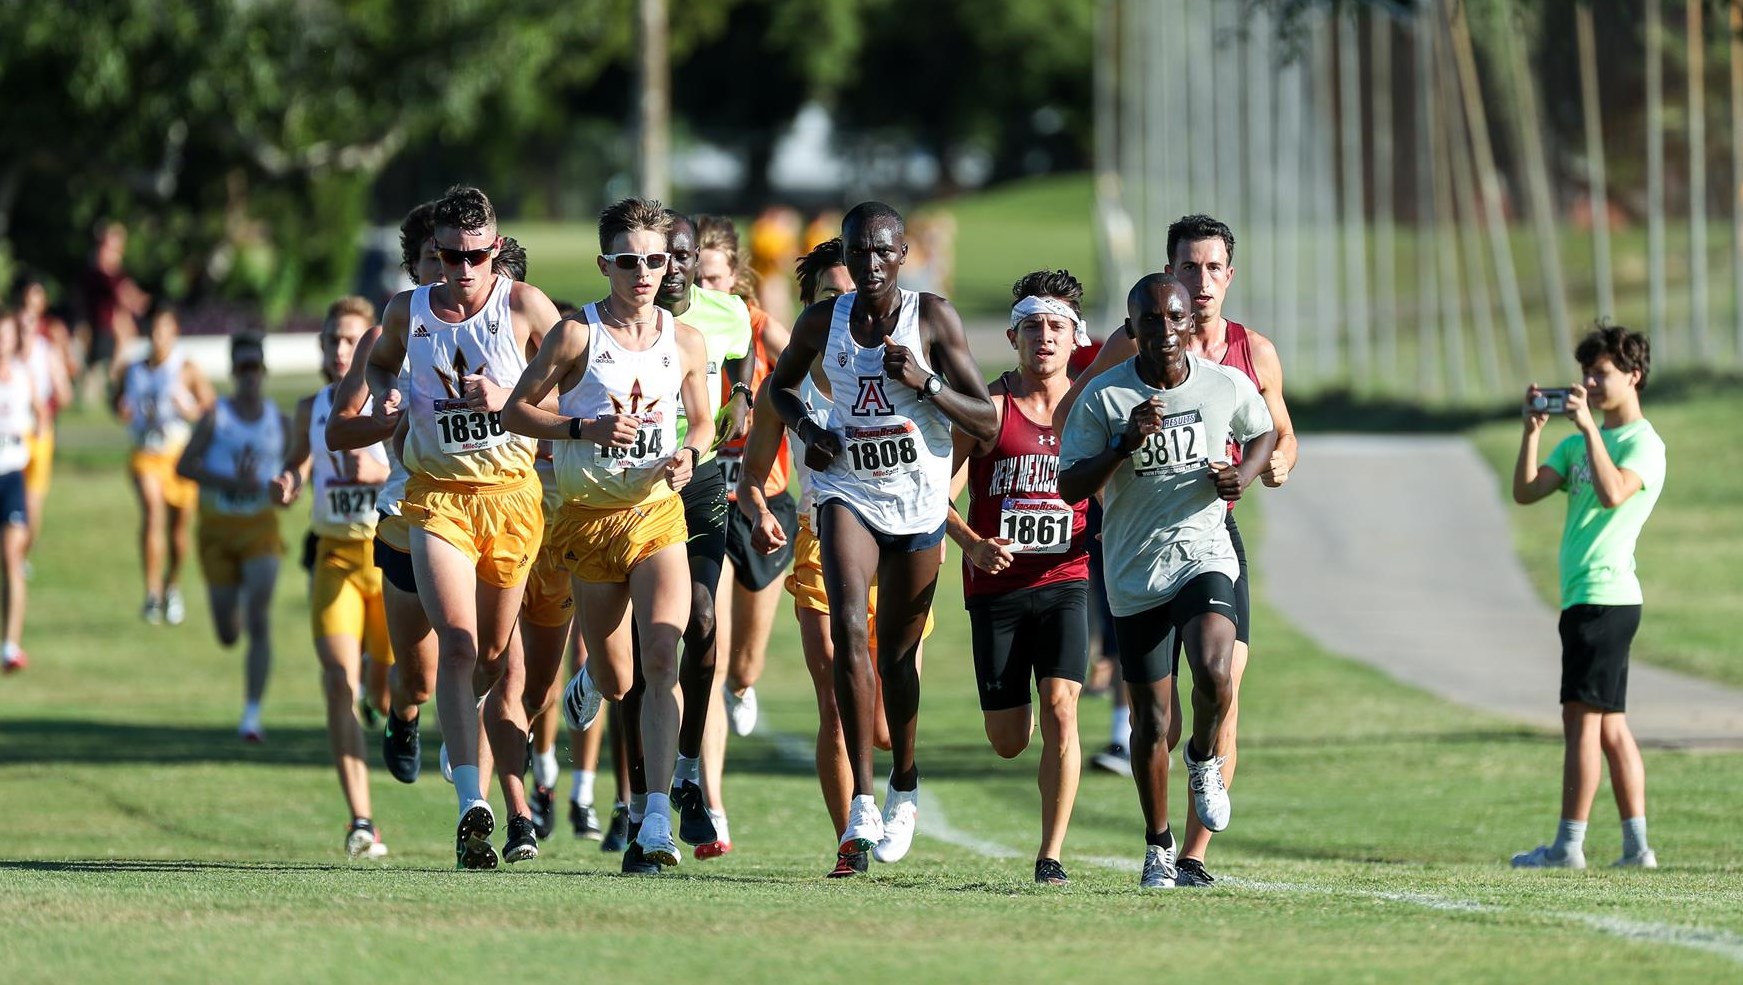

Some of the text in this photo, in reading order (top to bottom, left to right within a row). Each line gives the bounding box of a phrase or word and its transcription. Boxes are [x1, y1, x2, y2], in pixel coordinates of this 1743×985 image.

[852, 375, 896, 416] A
[438, 411, 506, 443] 1838
[1163, 413, 1196, 427] RESULTS
[847, 437, 918, 471] 1808
[1141, 425, 1198, 467] 3812
[989, 457, 1018, 497] NEW
[1003, 514, 1069, 545] 1861
